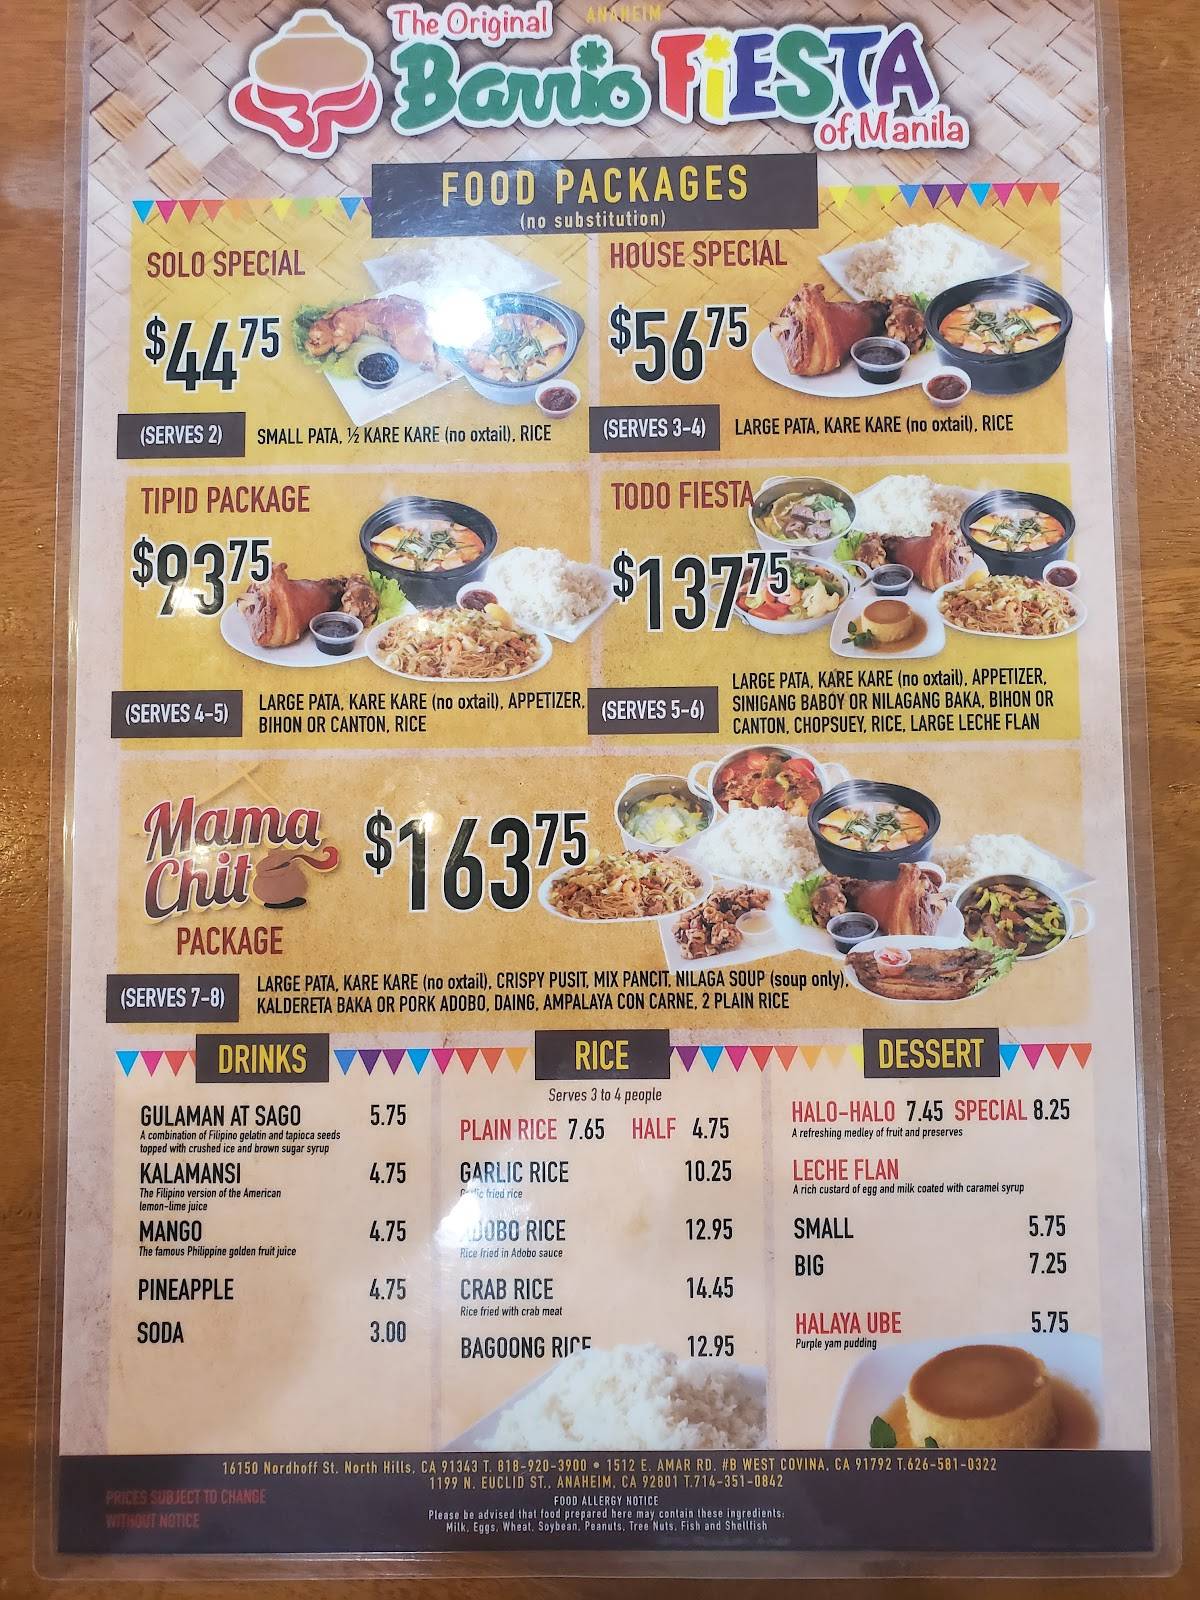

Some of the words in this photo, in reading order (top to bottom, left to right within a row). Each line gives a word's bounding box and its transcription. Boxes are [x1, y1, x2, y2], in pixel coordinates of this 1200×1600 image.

[393, 10, 439, 36] The
[447, 7, 547, 40] Original
[586, 5, 663, 23] ANAHEIM
[399, 39, 648, 129] Barrio
[819, 115, 854, 145] of
[860, 111, 965, 145] Manila
[441, 170, 538, 208] FOOD
[555, 164, 749, 204] PACKAGES
[519, 211, 549, 231] (no
[552, 209, 668, 230] substitution)
[147, 252, 206, 279] SOLO
[213, 249, 306, 277] SPECIAL
[610, 242, 686, 268] HOUSE
[693, 240, 788, 267] SPECIAL
[140, 426, 205, 446] (SERVES
[208, 425, 223, 444] 2)
[257, 428, 303, 445] SMALL
[308, 428, 343, 445] PATA,
[364, 427, 400, 443] KARE
[404, 426, 440, 443] KARE
[445, 426, 466, 444] (no
[470, 425, 516, 443] oxtail),
[520, 425, 551, 441] RICE
[603, 418, 668, 439] (SERVES
[141, 487, 200, 514] TIPID
[207, 485, 310, 513] PACKAGE
[611, 482, 671, 510] TODO
[680, 480, 755, 509] FIESTA
[602, 701, 667, 721] (SERVES
[732, 694, 796, 711] SINIGANG
[801, 693, 845, 710] BABOY
[850, 693, 868, 709] OR
[872, 692, 941, 709] NILAGANG
[945, 691, 985, 709] BAKA,
[989, 691, 1031, 707] BIHON
[1035, 690, 1054, 707] OR
[125, 705, 190, 725] (SERVES
[144, 797, 322, 863] Mama
[144, 852, 252, 921] Chit
[177, 927, 283, 955] PACKAGE
[120, 988, 186, 1009] (SERVES
[257, 997, 333, 1014] KALDERETA
[337, 996, 374, 1013] BAKA
[378, 996, 395, 1013] OR
[400, 996, 436, 1013] PORK
[440, 995, 491, 1014] ADOBO,
[494, 995, 539, 1011] DAING,
[543, 994, 613, 1010] AMPALAYA
[617, 993, 645, 1009] CON
[649, 993, 698, 1010] CARNE,
[702, 993, 710, 1009] 2
[714, 992, 754, 1008] PLAIN
[758, 992, 789, 1008] RICE
[218, 1044, 307, 1073] DRINKS
[575, 1040, 629, 1071] RICE
[879, 1038, 985, 1069] DESSERT
[549, 1089, 587, 1102] Serves
[590, 1089, 597, 1101] 3
[600, 1089, 611, 1100] to
[614, 1089, 622, 1100] 4
[625, 1088, 661, 1104] people
[140, 1105, 225, 1126] GULAMAN
[230, 1105, 250, 1126] AT
[255, 1105, 301, 1126] SAGO
[370, 1104, 406, 1126] 5.75
[792, 1101, 895, 1122] HALO-HALO
[906, 1100, 943, 1121] 7.45
[954, 1099, 1027, 1121] SPECIAL
[1033, 1099, 1070, 1120] 8.25
[460, 1119, 513, 1140] PLAIN
[518, 1118, 557, 1140] RICE
[568, 1118, 605, 1139] 7.65
[632, 1118, 676, 1139] HALF
[692, 1117, 729, 1139] 4.75
[140, 1163, 241, 1184] KALAMANSI
[369, 1162, 406, 1183] 4.75
[460, 1162, 523, 1183] GARLIC
[530, 1161, 569, 1182] RICE
[685, 1160, 732, 1182] 10.25
[793, 1159, 848, 1181] LECHE
[855, 1159, 899, 1180] FLAN
[139, 1188, 153, 1198] The
[156, 1188, 185, 1201] Filipino
[187, 1189, 217, 1198] version
[219, 1188, 228, 1198] of
[228, 1188, 241, 1198] the
[243, 1188, 281, 1198] American
[139, 1221, 202, 1242] MANGO
[369, 1220, 406, 1242] 4.75
[466, 1220, 519, 1241] DOBO
[526, 1220, 566, 1241] RICE
[686, 1219, 733, 1240] 12.95
[794, 1217, 854, 1239] SMALL
[1028, 1215, 1066, 1236] 5.75
[795, 1254, 824, 1276] BIG
[1029, 1252, 1067, 1274] 7.25
[138, 1278, 234, 1300] PINEAPPLE
[369, 1278, 406, 1300] 4.75
[460, 1278, 506, 1300] CRAB
[514, 1278, 553, 1299] RICE
[686, 1276, 734, 1298] 14.45
[460, 1306, 478, 1316] Rice
[480, 1306, 499, 1316] fried
[502, 1306, 519, 1316] with
[521, 1306, 540, 1316] crab
[542, 1307, 562, 1316] meat
[137, 1322, 184, 1343] SODA
[370, 1321, 406, 1342] 3.00
[796, 1313, 861, 1334] HALAYA
[867, 1312, 902, 1333] UBE
[1031, 1311, 1068, 1333] 5.75
[461, 1337, 544, 1358] BAGOONG
[687, 1335, 734, 1357] 12.95
[796, 1338, 822, 1350] Purple
[824, 1341, 842, 1350] yam
[844, 1338, 877, 1350] pudding
[223, 1462, 259, 1476] 16150
[264, 1461, 319, 1475] Nordhoff
[323, 1461, 339, 1475] St.
[344, 1461, 379, 1474] North
[421, 1460, 437, 1473] CA
[441, 1460, 478, 1473] 91343
[483, 1460, 494, 1473] T.
[498, 1459, 587, 1473] 818-920-3900
[606, 1459, 636, 1472] 1512
[641, 1458, 652, 1472] E.
[657, 1458, 692, 1472] AMAR
[697, 1458, 718, 1472] RD.
[722, 1457, 738, 1472] #B
[742, 1457, 775, 1471] WEST
[780, 1457, 830, 1472] COVINA,
[835, 1457, 851, 1471] CA
[855, 1457, 892, 1471] 91792
[897, 1457, 997, 1471] T.626-581-0322
[554, 1496, 578, 1506] FOOD
[582, 1496, 622, 1506] ALLERGY
[627, 1496, 659, 1505] NOTICE
